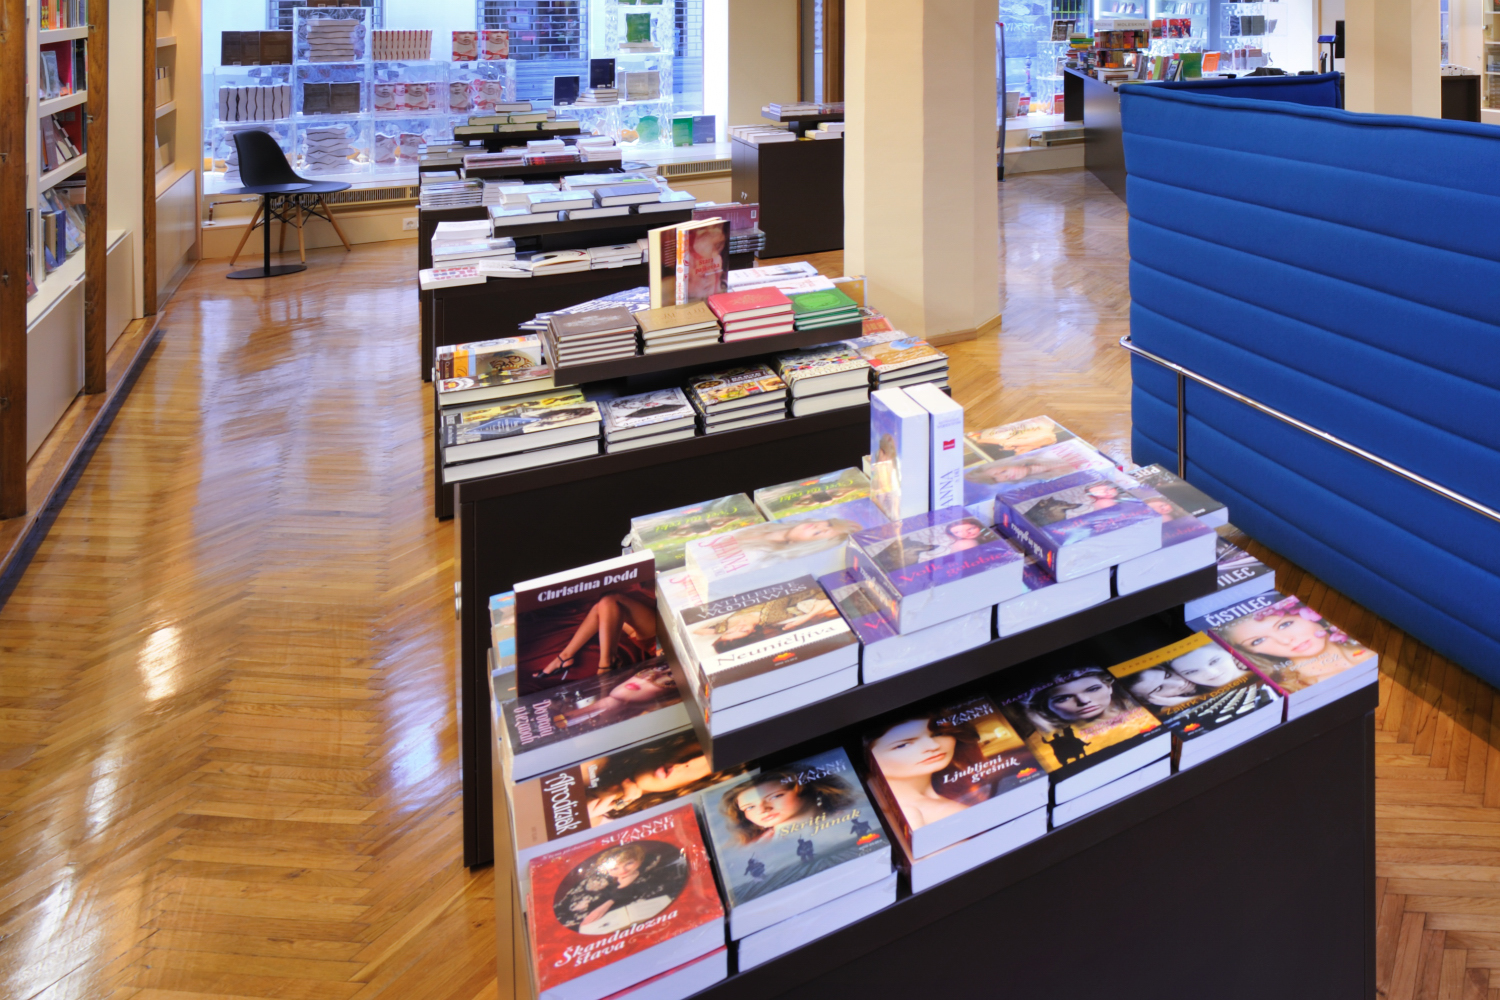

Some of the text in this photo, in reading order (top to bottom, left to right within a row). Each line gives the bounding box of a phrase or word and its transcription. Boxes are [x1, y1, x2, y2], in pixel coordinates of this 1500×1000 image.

[538, 568, 638, 602] Christina Dodd
[1217, 567, 1255, 587] TILEC
[697, 584, 807, 619] WOODIWISS
[699, 584, 785, 612] KATHLEEN
[1205, 596, 1272, 627] ČISTILEC
[717, 626, 836, 666] Neuničljiva
[1273, 660, 1293, 671] Ne
[1166, 698, 1198, 716] Zajtrk
[1210, 675, 1249, 699] postelji
[936, 703, 990, 726] SUZANNE
[951, 707, 994, 726] ENOCH
[780, 758, 844, 785] SUZANNE
[798, 764, 847, 786] ENOCH
[943, 755, 1002, 784] Ljubljeni
[971, 757, 1020, 783] grešnik
[543, 772, 582, 835] Afrodiziak
[601, 815, 673, 846] SUZANNE
[619, 821, 675, 846] ENOCH
[780, 812, 827, 837] Skriti
[811, 809, 861, 836] junak
[554, 910, 678, 968] Škandalozna
[574, 940, 625, 968] slava
